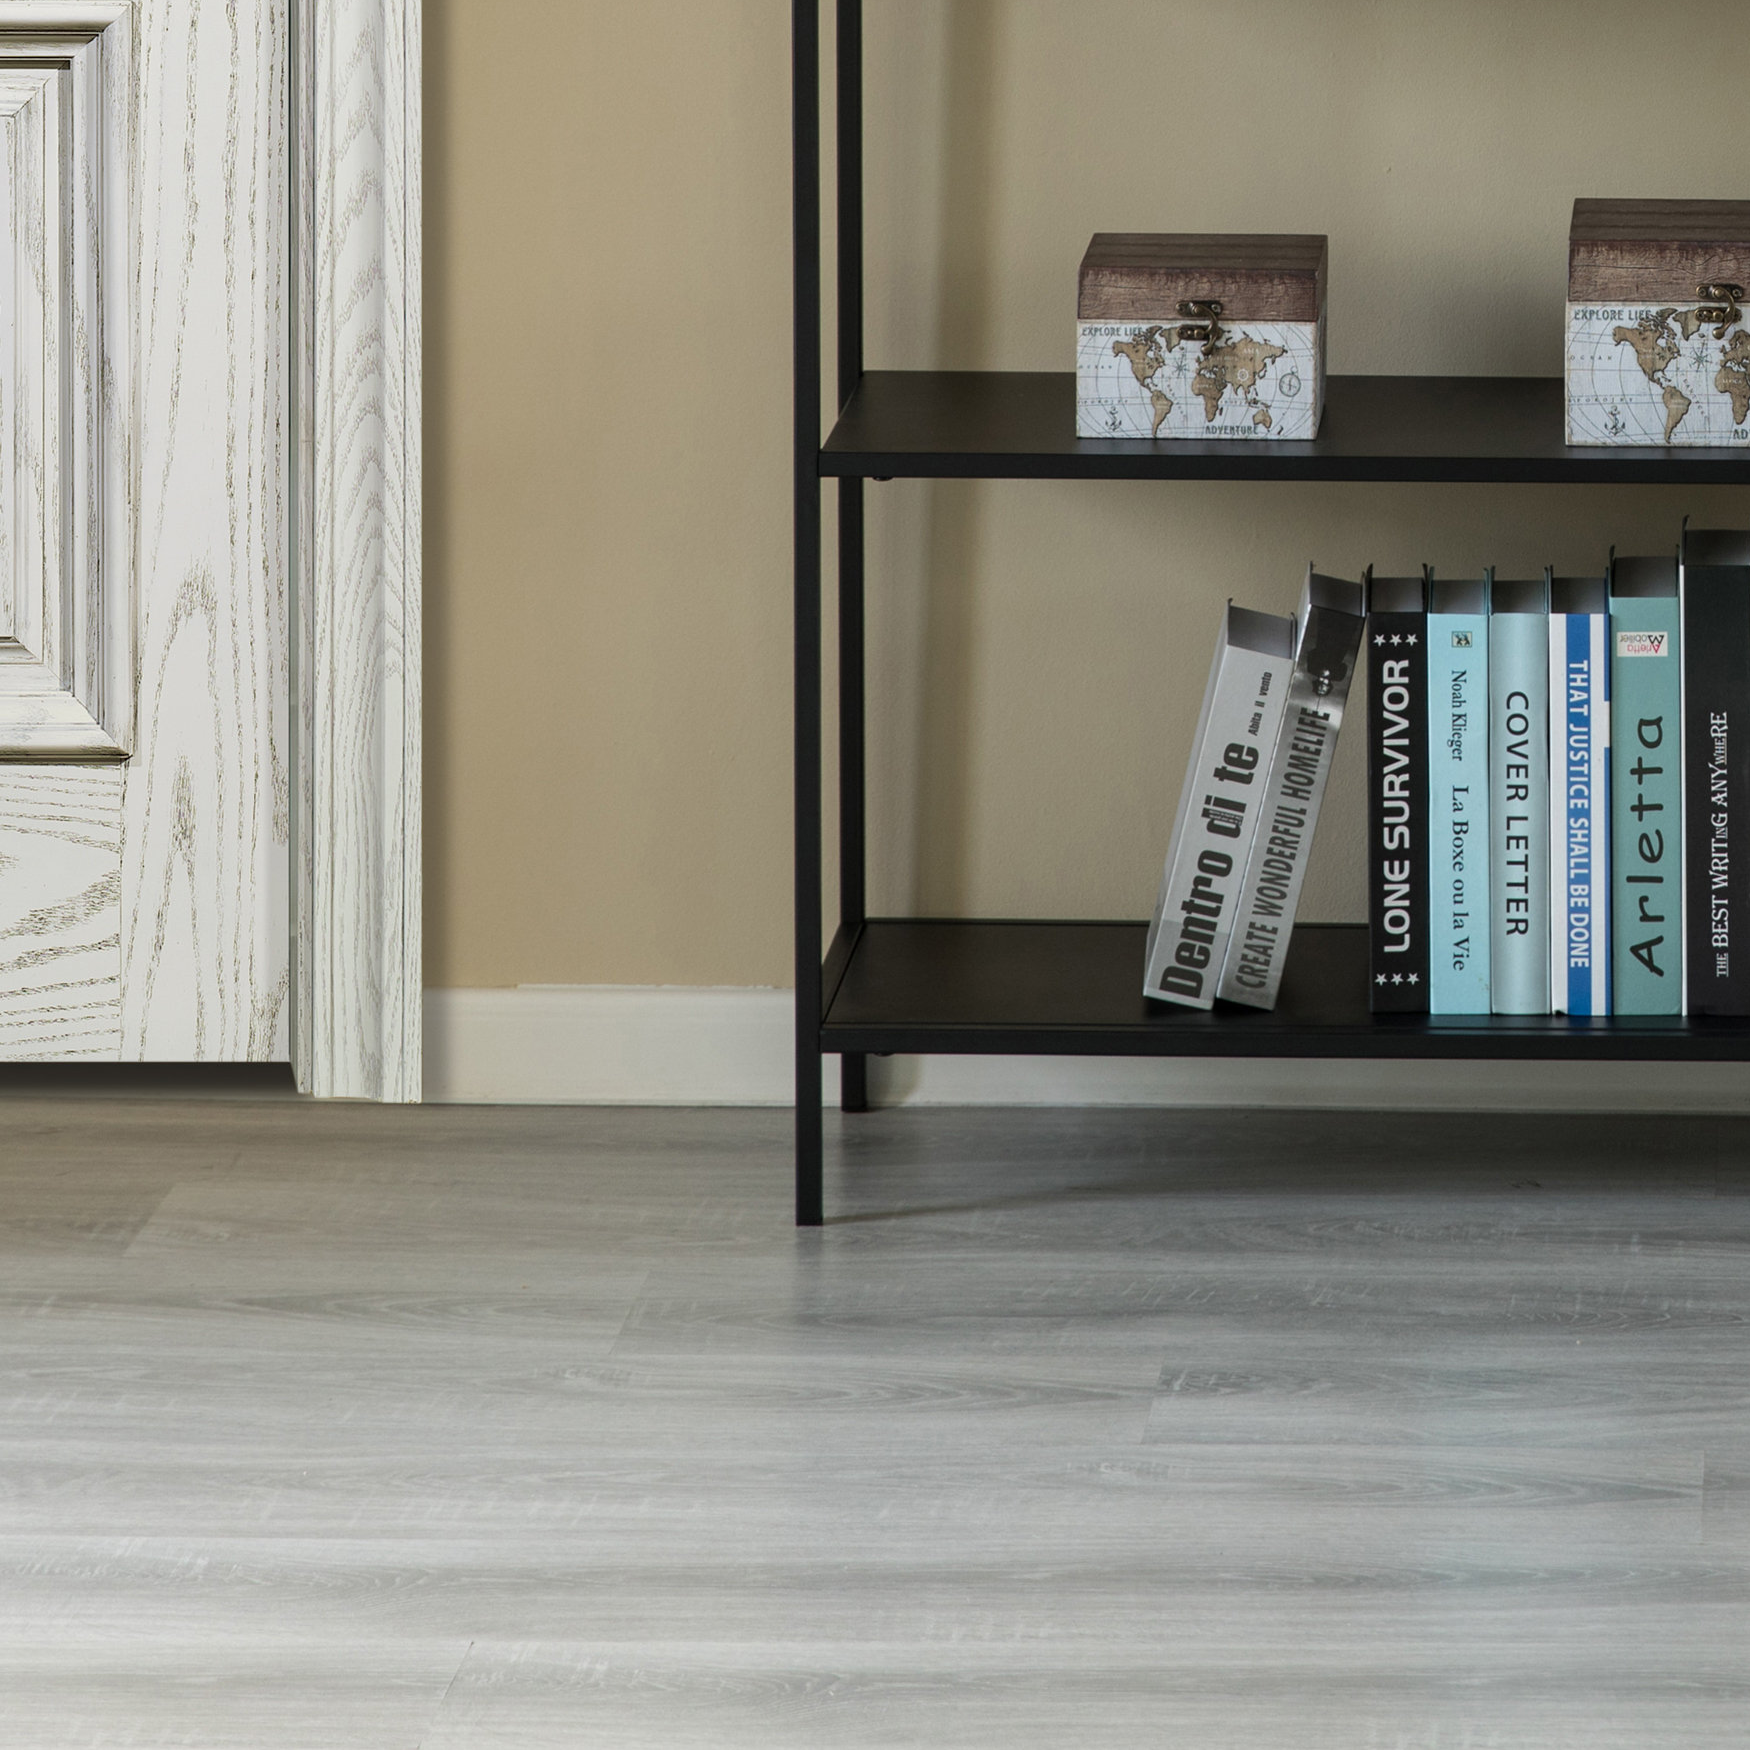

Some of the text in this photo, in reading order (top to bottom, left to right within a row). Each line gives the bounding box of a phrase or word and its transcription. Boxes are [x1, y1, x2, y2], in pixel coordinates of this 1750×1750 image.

[1082, 326, 1121, 336] EXPLORE
[1574, 309, 1624, 321] EXPLORE
[1205, 425, 1259, 436] ADVENTURE
[1213, 742, 1260, 786] te
[1247, 711, 1263, 737] Abita
[1259, 671, 1272, 696] vento
[1446, 669, 1468, 762] Noah Klieger
[1201, 793, 1248, 839] di
[1235, 706, 1331, 991] CREATE WONDERFUL HOMELIFE
[1382, 658, 1411, 953] LONE SURVIVOR
[1505, 690, 1530, 937] COVER LETTER
[1568, 659, 1591, 969] THAT JUSTICE SHALL BE DONE
[1710, 710, 1729, 978] THE BEST WRITING ANYWHERE
[1159, 849, 1233, 999] Dentro
[1452, 784, 1471, 972] La Boxe ou la Vie
